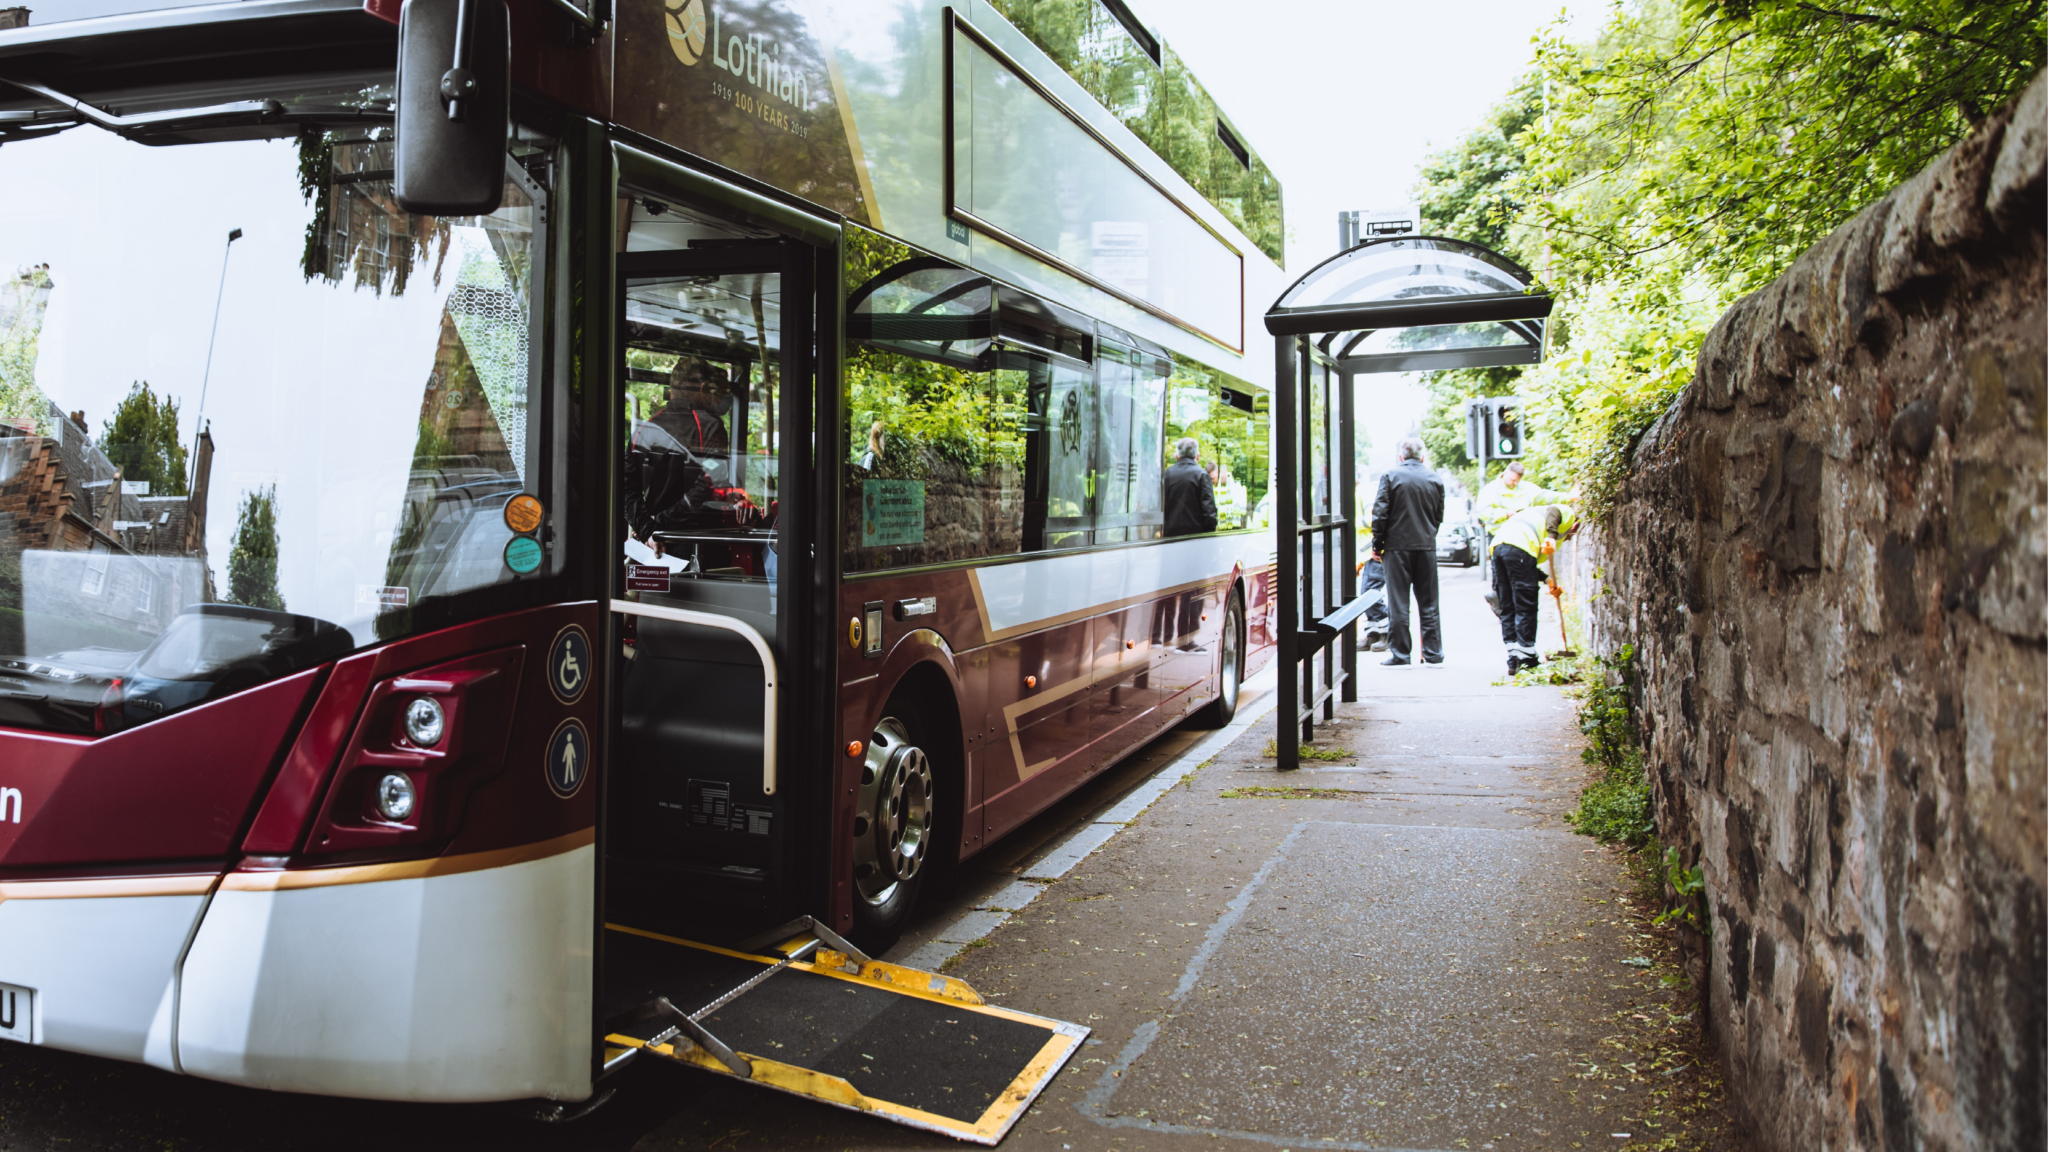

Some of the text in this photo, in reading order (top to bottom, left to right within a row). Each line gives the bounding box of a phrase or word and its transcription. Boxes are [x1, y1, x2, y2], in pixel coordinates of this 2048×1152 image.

[713, 11, 808, 111] Lothian
[712, 81, 808, 139] 1919 100 YEARS 2019
[637, 568, 659, 576] Emergency
